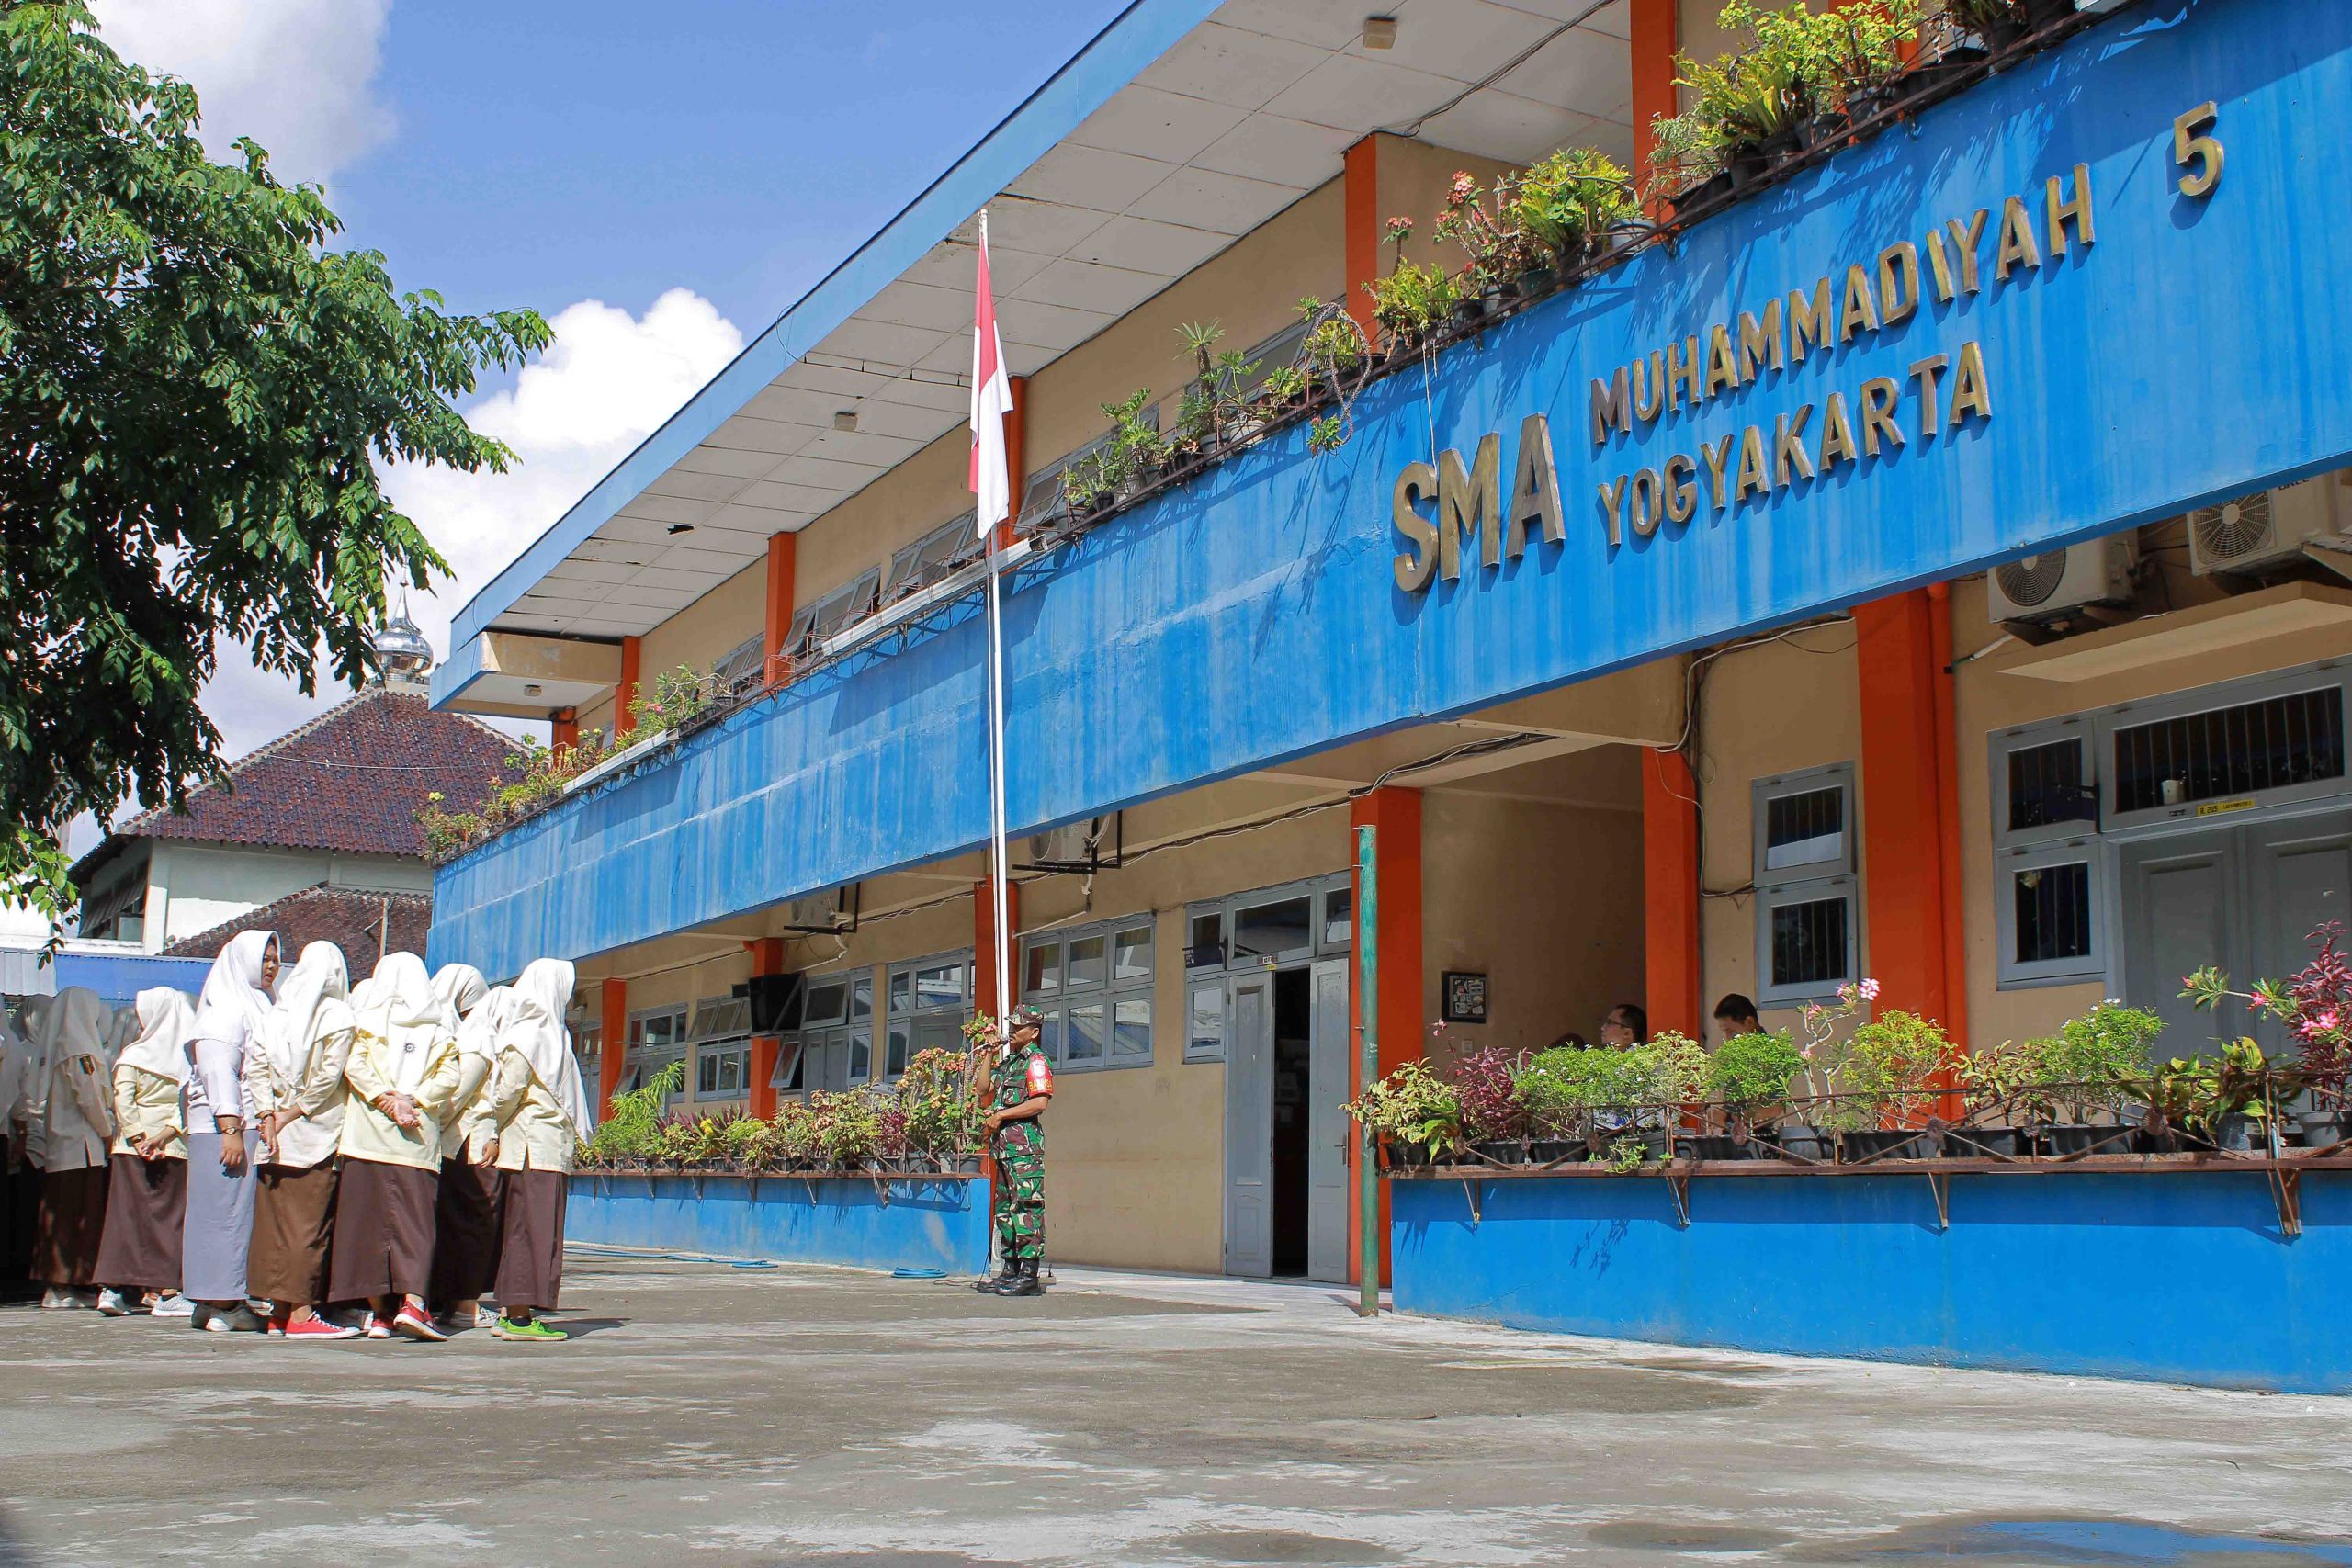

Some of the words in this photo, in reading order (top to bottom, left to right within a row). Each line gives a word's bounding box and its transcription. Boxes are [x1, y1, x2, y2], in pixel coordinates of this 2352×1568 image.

[1590, 162, 2096, 446] MUHAMMADIYAH
[2174, 100, 2224, 197] 5
[1393, 412, 1566, 592] SMA
[1597, 341, 1992, 547] YOGYAKARTA
